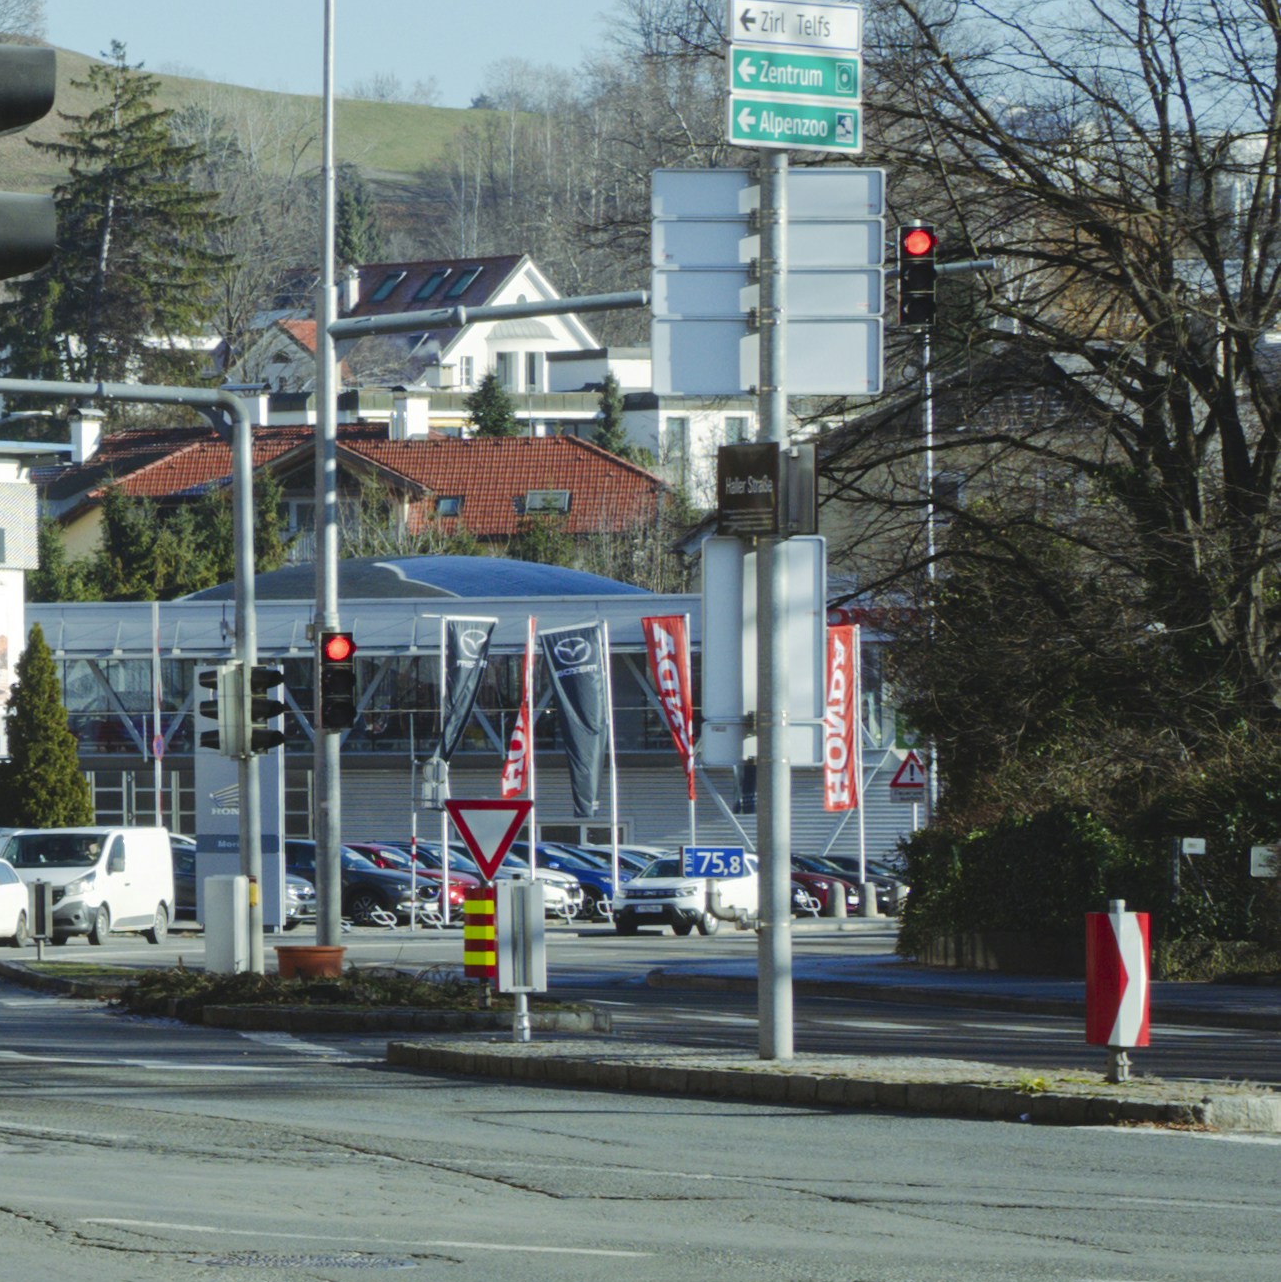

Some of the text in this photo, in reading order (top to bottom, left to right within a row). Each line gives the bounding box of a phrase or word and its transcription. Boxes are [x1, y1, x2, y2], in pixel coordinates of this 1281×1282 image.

[760, 11, 831, 37] Zirl Telfs
[759, 60, 823, 87] Zentrum
[759, 110, 828, 138] Alpenzoo
[211, 807, 239, 815] HON
[696, 852, 741, 876] 75,8
